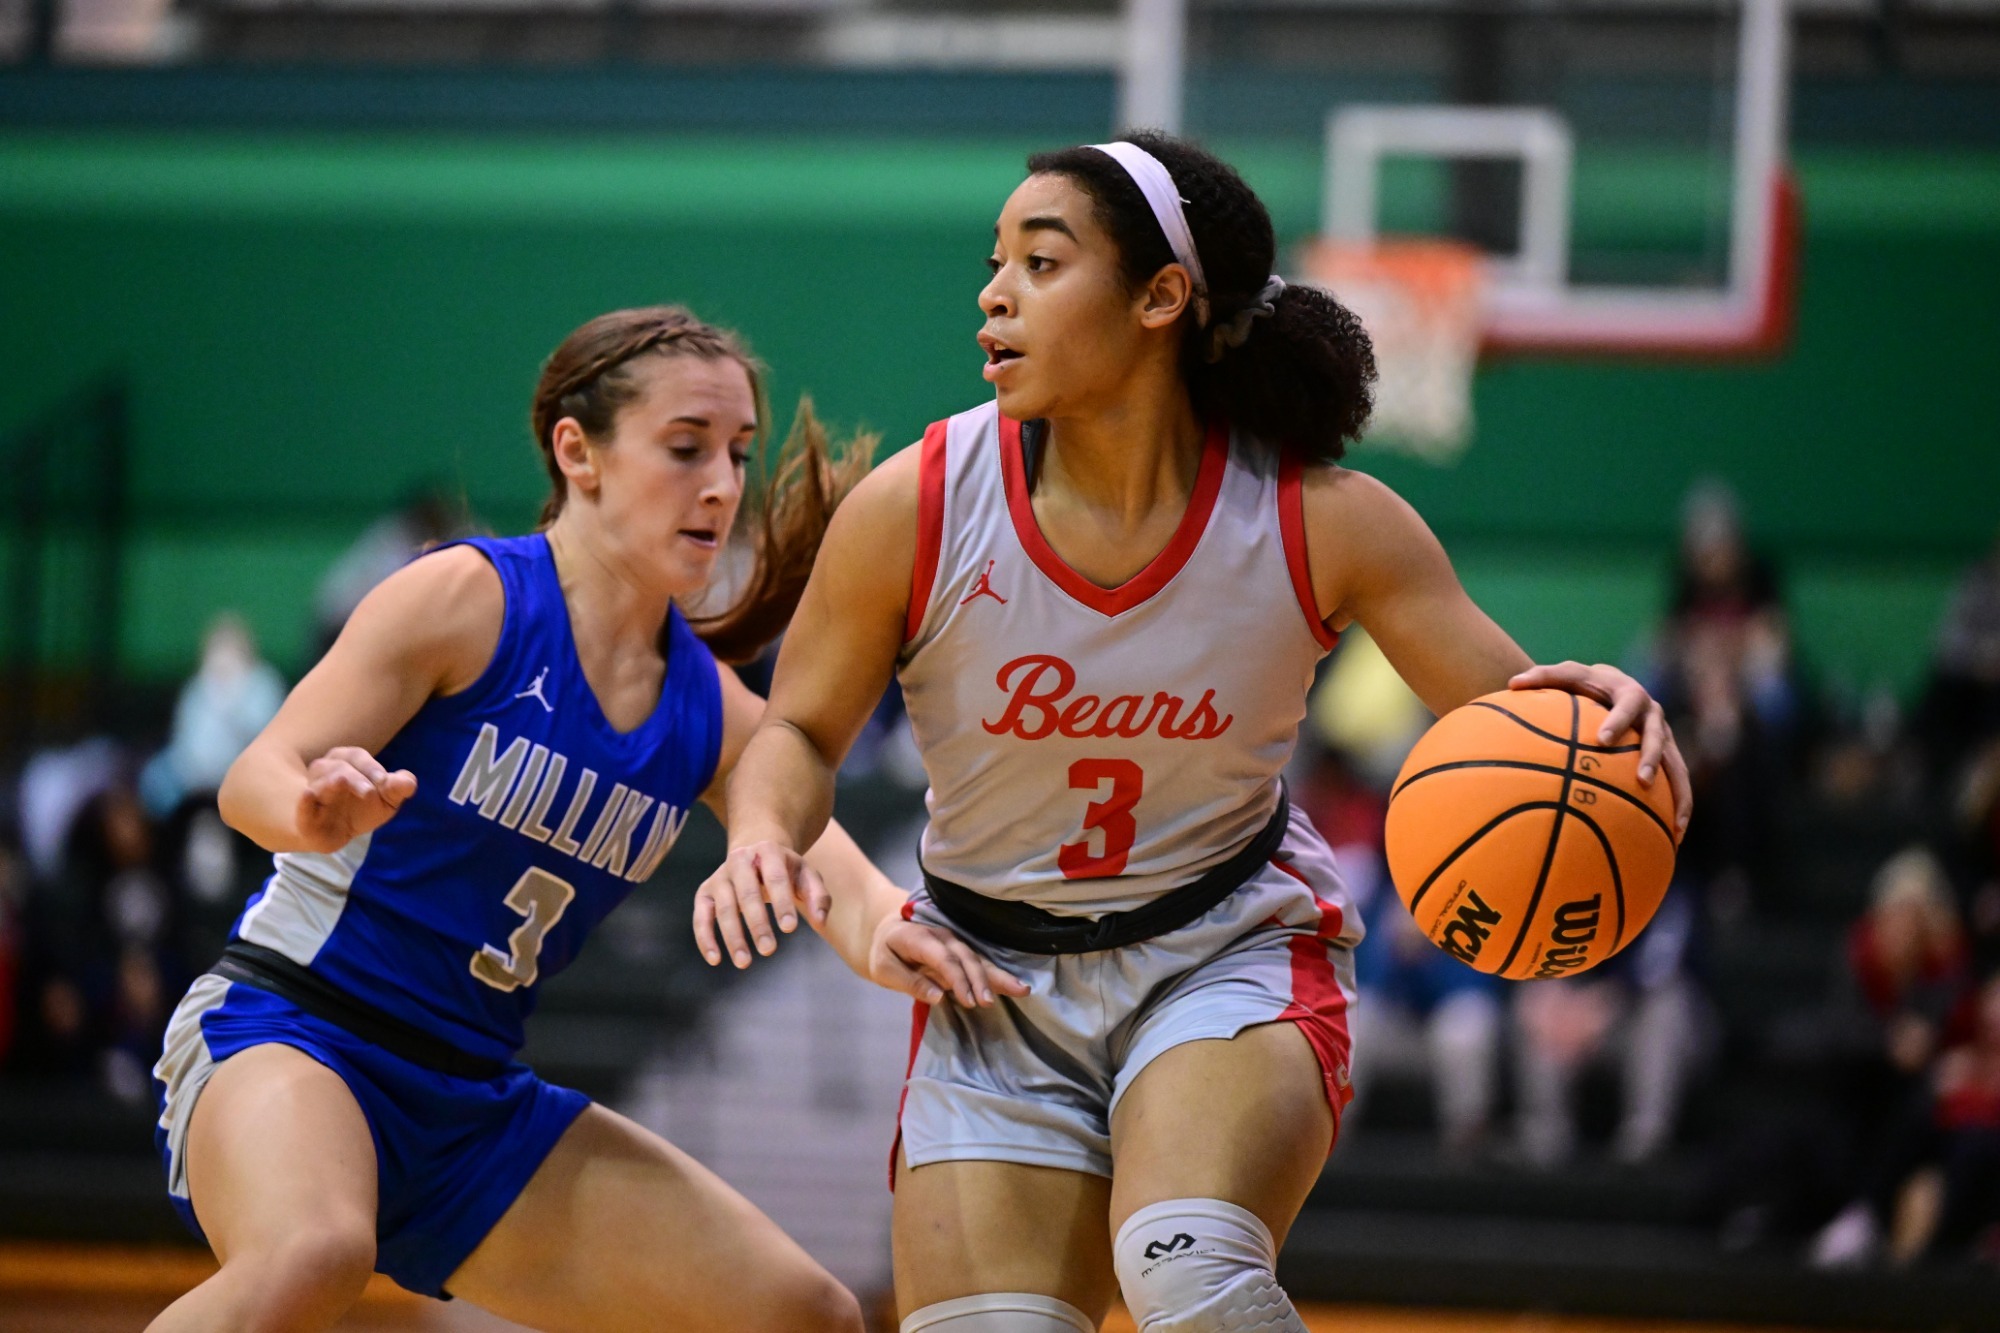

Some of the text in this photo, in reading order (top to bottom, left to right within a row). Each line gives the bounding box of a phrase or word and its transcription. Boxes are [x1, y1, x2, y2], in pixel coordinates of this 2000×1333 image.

[982, 654, 1234, 740] Bears
[448, 722, 690, 883] MILLIKIN
[1057, 758, 1144, 880] 3
[469, 865, 576, 993] 3
